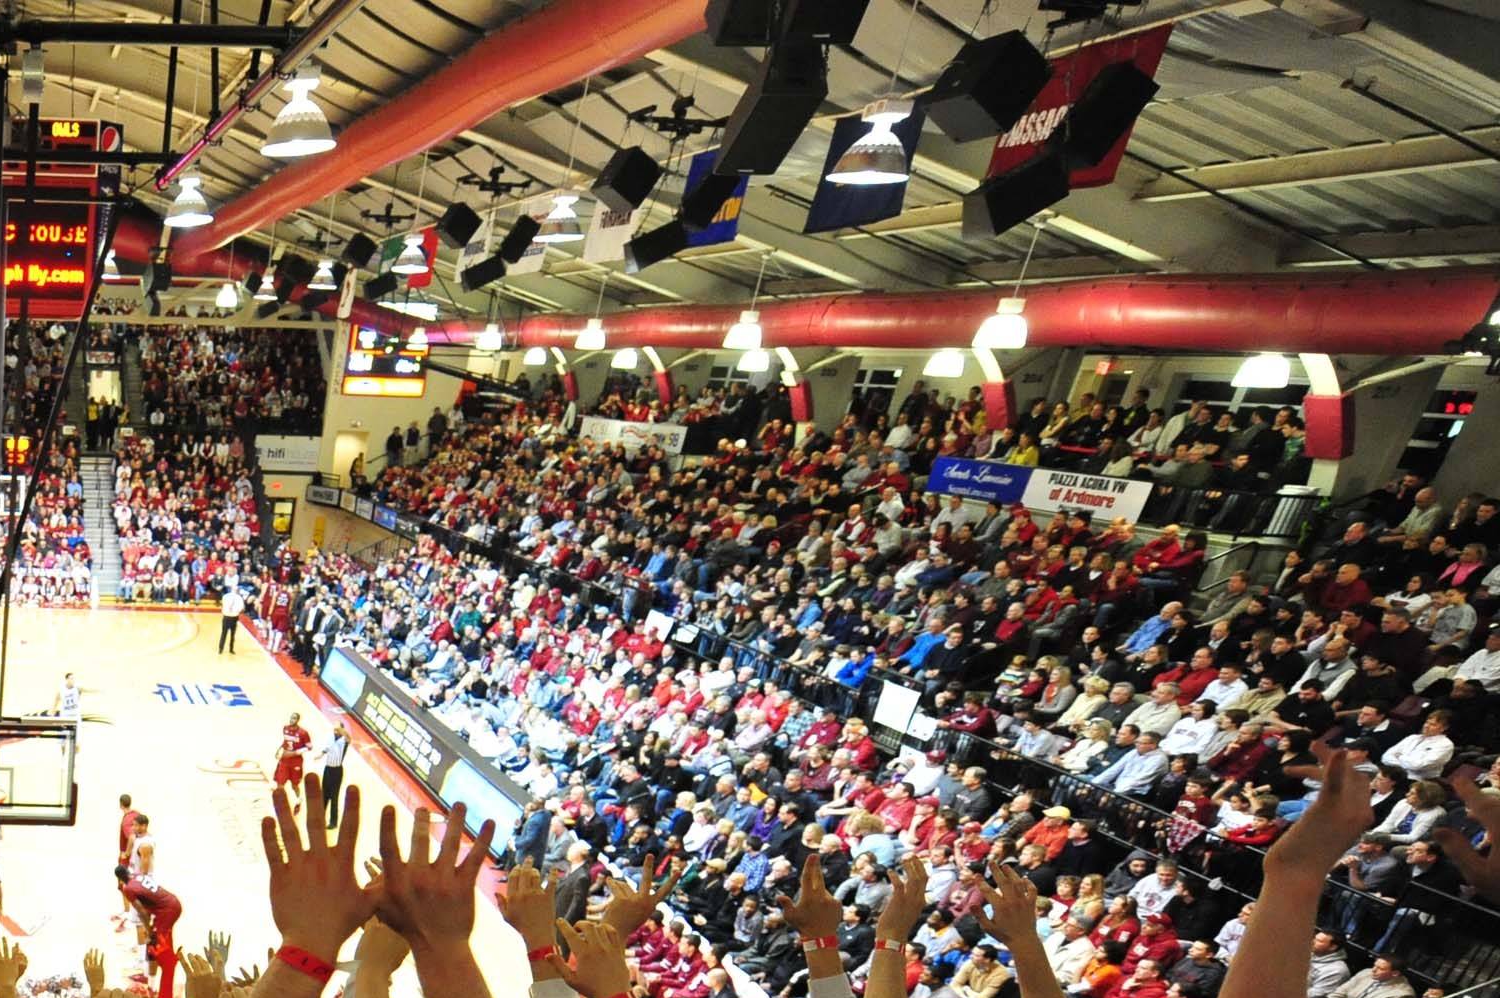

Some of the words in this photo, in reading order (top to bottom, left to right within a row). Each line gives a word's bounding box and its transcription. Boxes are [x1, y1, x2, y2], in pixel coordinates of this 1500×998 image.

[1048, 472, 1077, 487] PIAZZA
[1081, 477, 1110, 492] ACURA
[1112, 480, 1129, 493] VW
[1048, 486, 1061, 501] of
[1061, 488, 1116, 509] Ardmore
